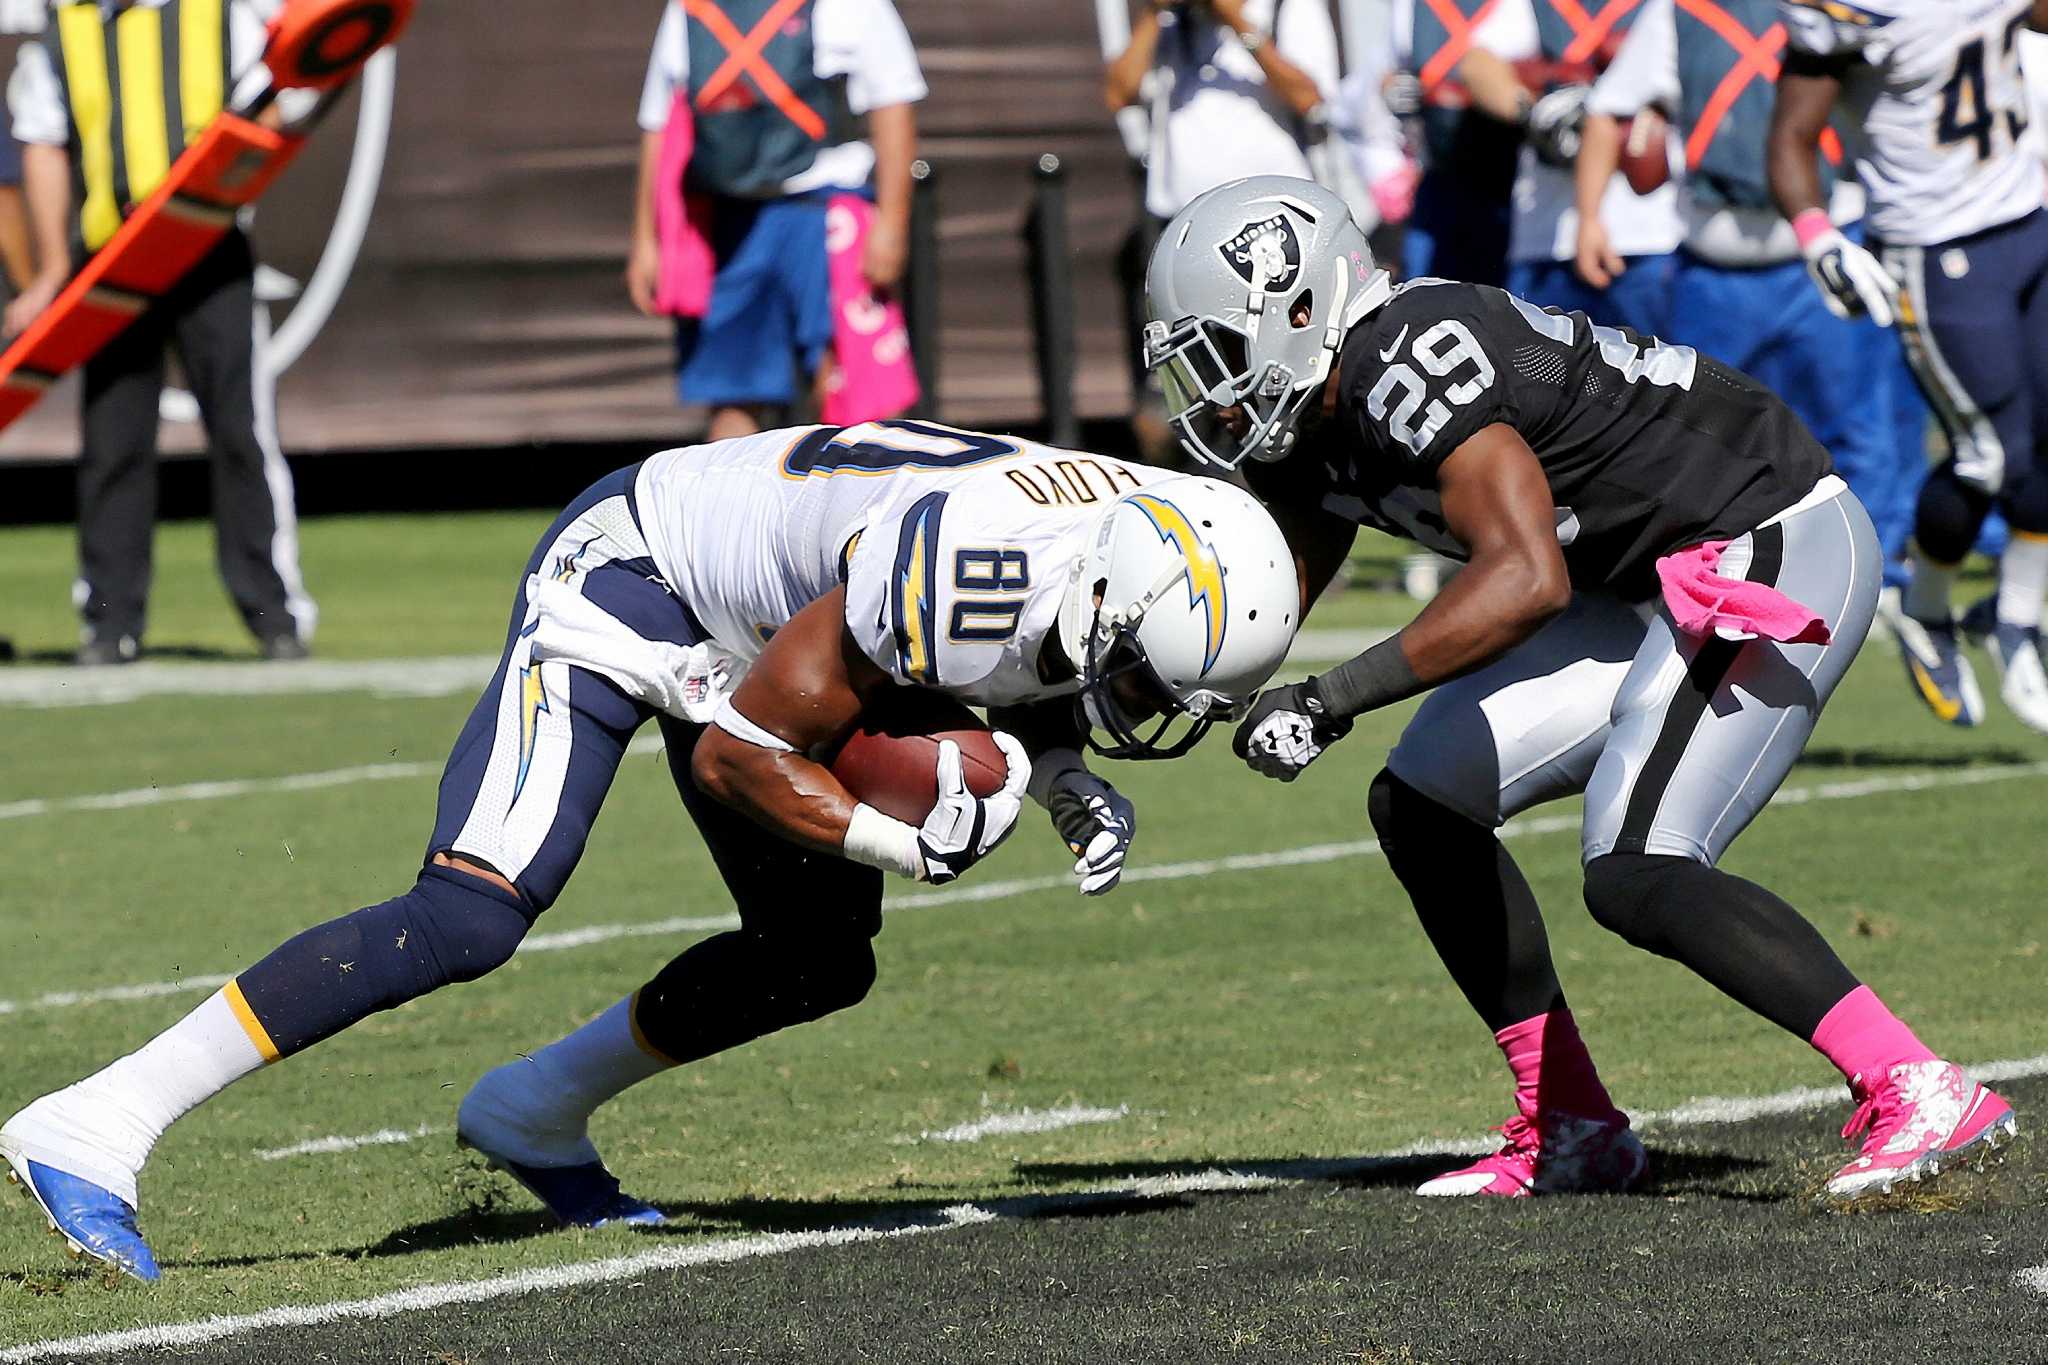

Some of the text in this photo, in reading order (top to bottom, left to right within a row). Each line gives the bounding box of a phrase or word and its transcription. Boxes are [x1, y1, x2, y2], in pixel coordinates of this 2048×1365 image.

[1224, 216, 1283, 253] RAIDERS
[1367, 319, 1496, 456] 29
[1004, 458, 1142, 506] FLOYD
[946, 546, 1029, 645] 80
